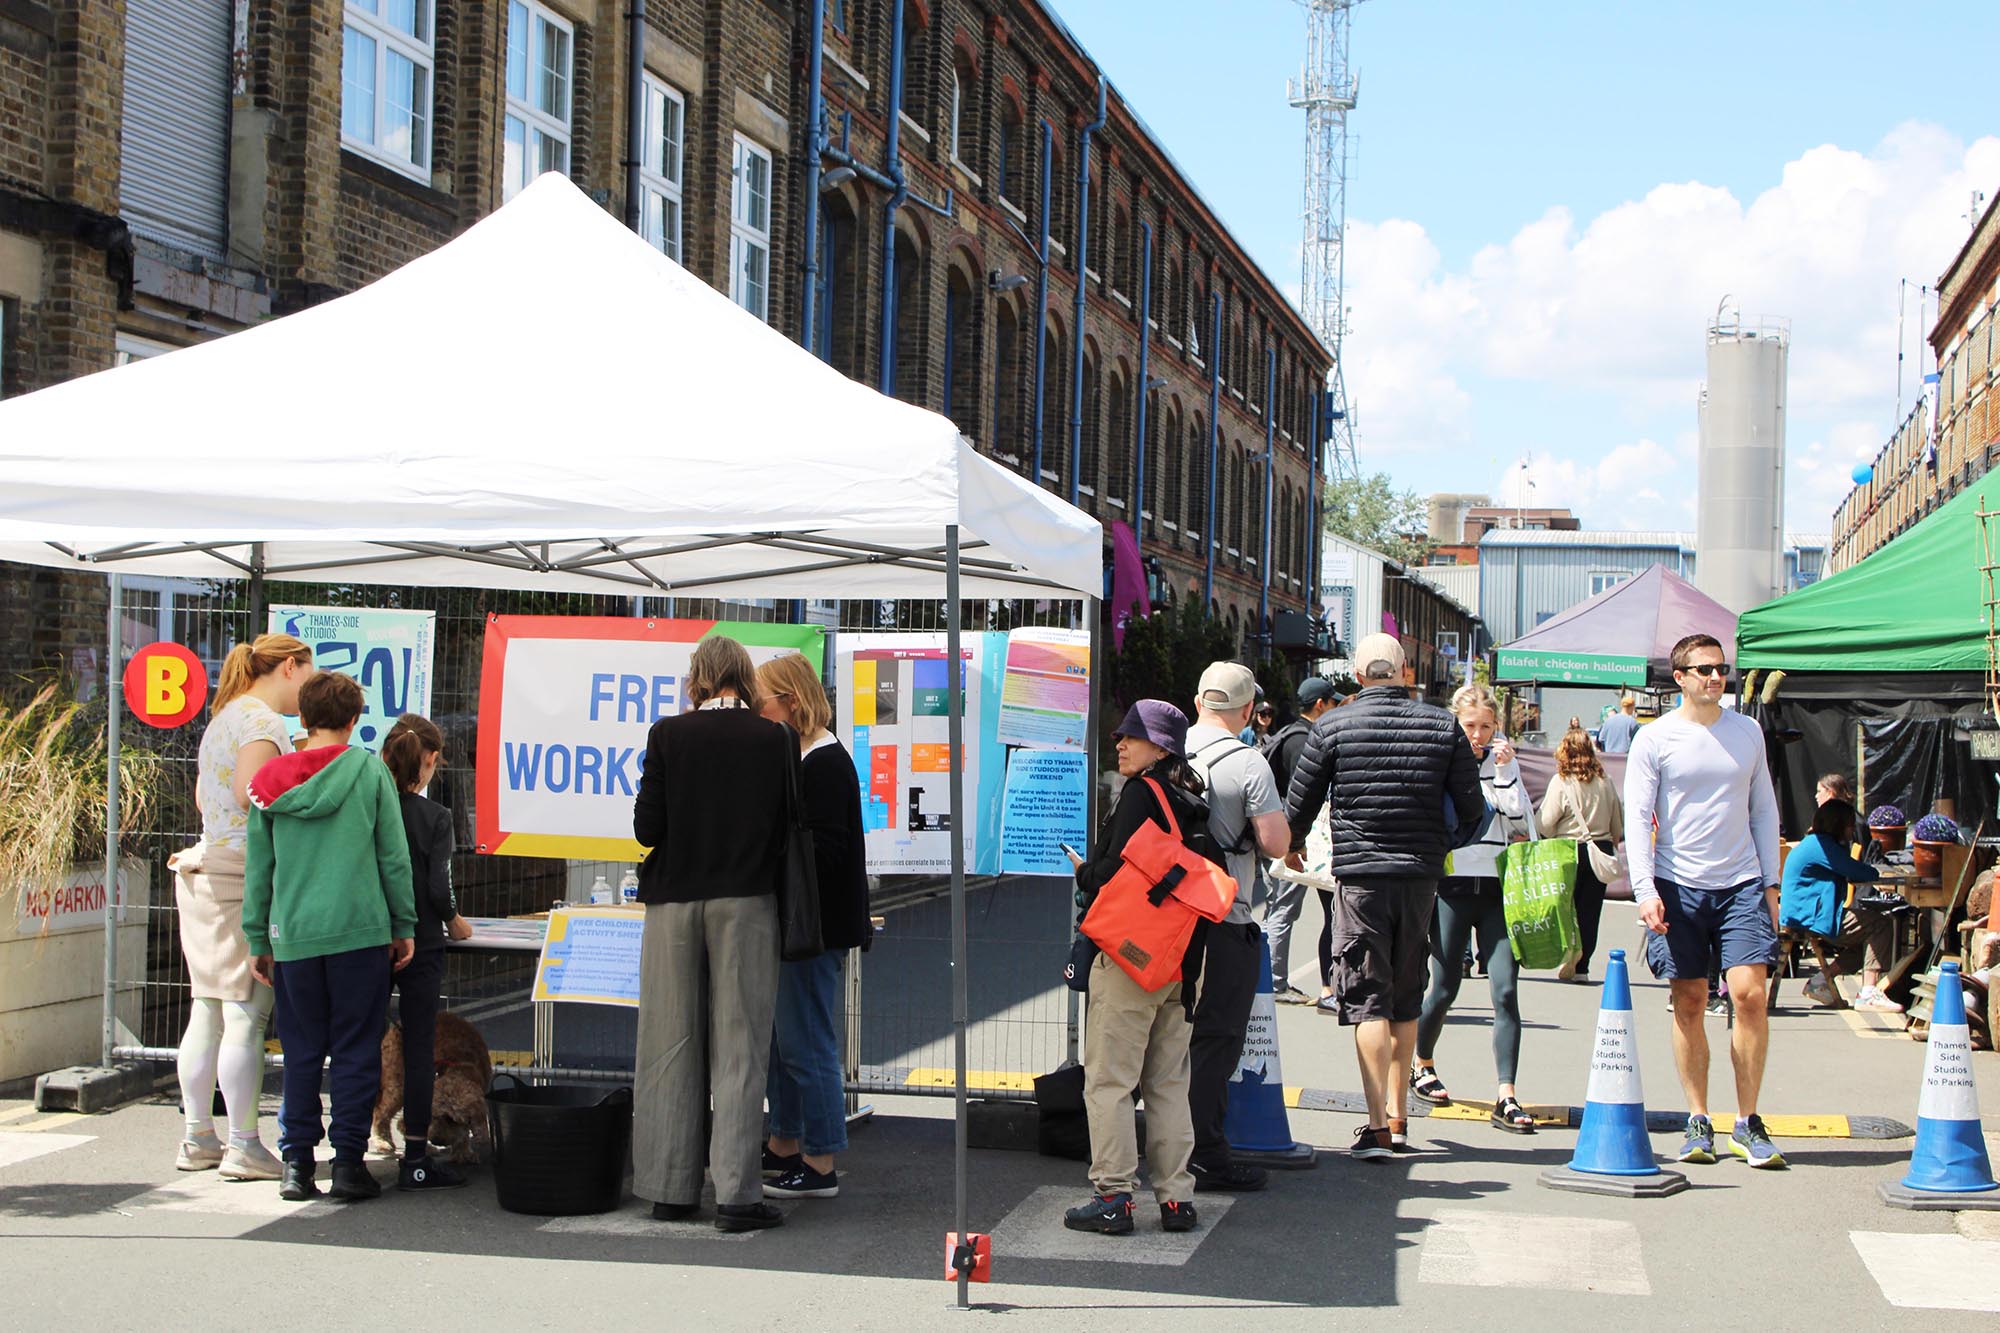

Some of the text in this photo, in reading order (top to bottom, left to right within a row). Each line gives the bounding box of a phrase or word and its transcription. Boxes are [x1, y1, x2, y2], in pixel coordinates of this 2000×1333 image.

[309, 614, 360, 628] THAMES-SIDE
[304, 628, 337, 640] STUDIOS
[1501, 655, 1644, 673] falafel chicken halloumi
[146, 655, 188, 716] B
[1010, 803, 1033, 811] Gallery
[1502, 882, 1569, 906] AT. SLEEP.
[26, 883, 120, 918] NO PARKIN
[595, 920, 644, 928] CHILDREN'
[1507, 916, 1556, 937] PEAT.
[616, 931, 642, 939] SHEE
[1247, 1025, 1267, 1033] Side
[1597, 1026, 1628, 1035] Thames
[1601, 1038, 1620, 1046] Side
[1933, 1041, 1968, 1049] Thames
[1248, 1048, 1278, 1058] Parking
[1596, 1050, 1627, 1059] Studios
[1940, 1053, 1961, 1061] Side
[1601, 1063, 1633, 1072] Parking
[1934, 1065, 1968, 1074] Studios
[1928, 1078, 1974, 1087] No Parking
